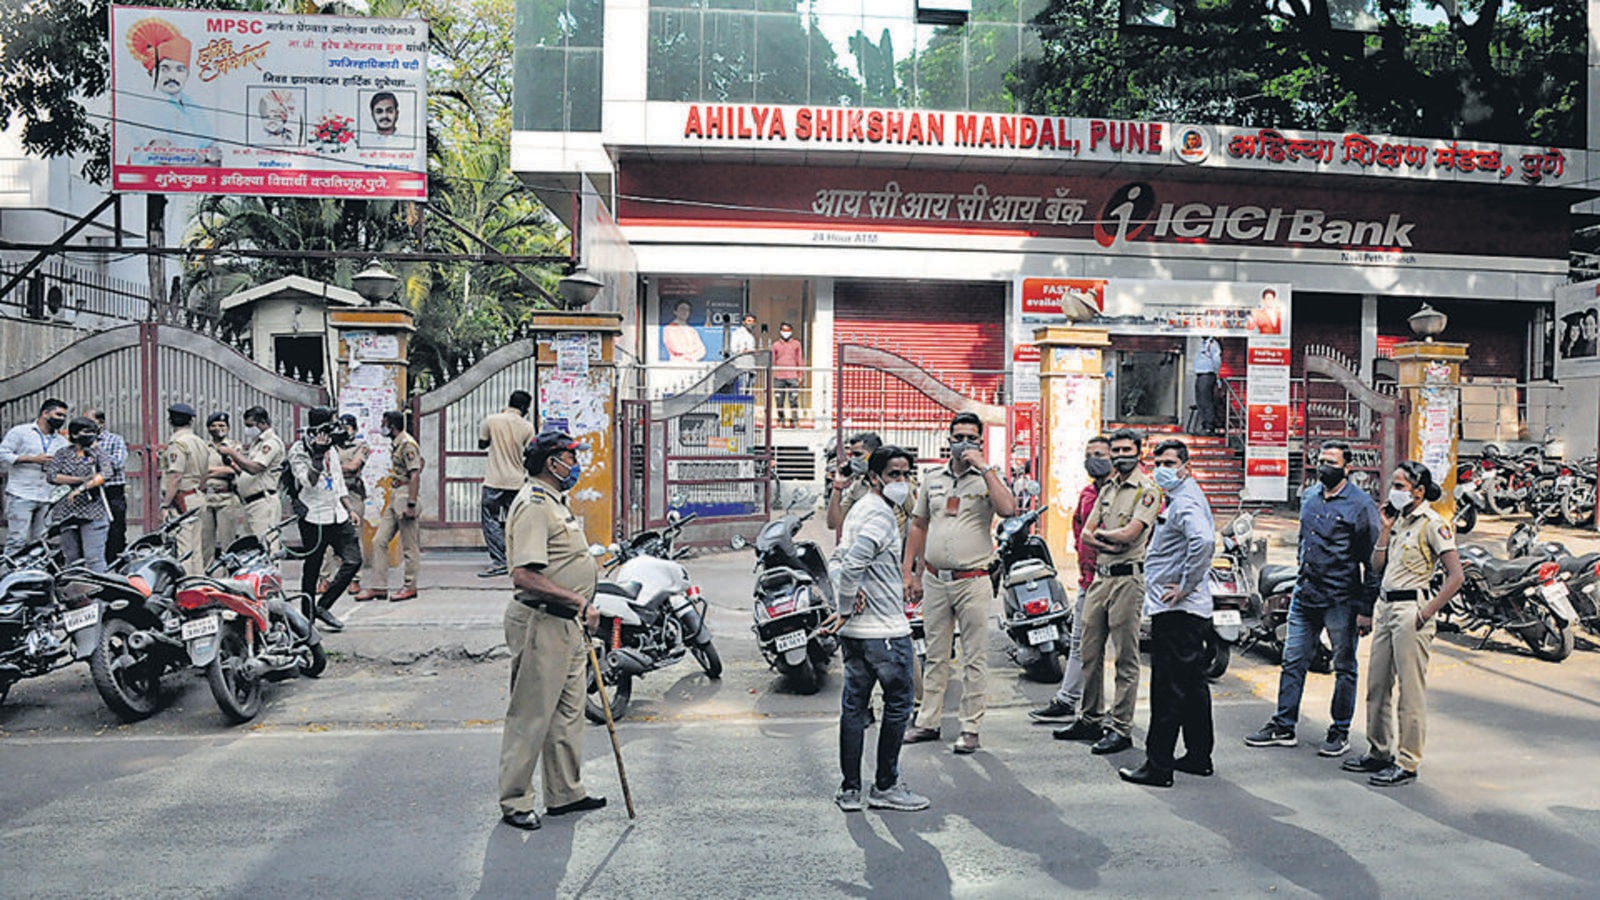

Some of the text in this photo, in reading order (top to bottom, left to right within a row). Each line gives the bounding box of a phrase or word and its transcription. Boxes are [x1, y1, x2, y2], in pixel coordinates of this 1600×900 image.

[206, 18, 262, 34] MPSC
[684, 105, 1163, 156] AHILYA SHIKSHAN MANDAL, PUNE
[1227, 128, 1336, 164] अहिल्या
[1342, 132, 1428, 171] शिक्षण
[1520, 147, 1566, 184] पुणे
[811, 188, 866, 218] आय
[868, 181, 901, 219] सी
[901, 191, 954, 221] आय
[956, 184, 988, 222] सी
[988, 195, 1041, 224] आय
[854, 233, 879, 243] ATM
[1153, 203, 1284, 241] ICICI
[1287, 209, 1416, 248] Bank
[1364, 252, 1384, 262] Peth
